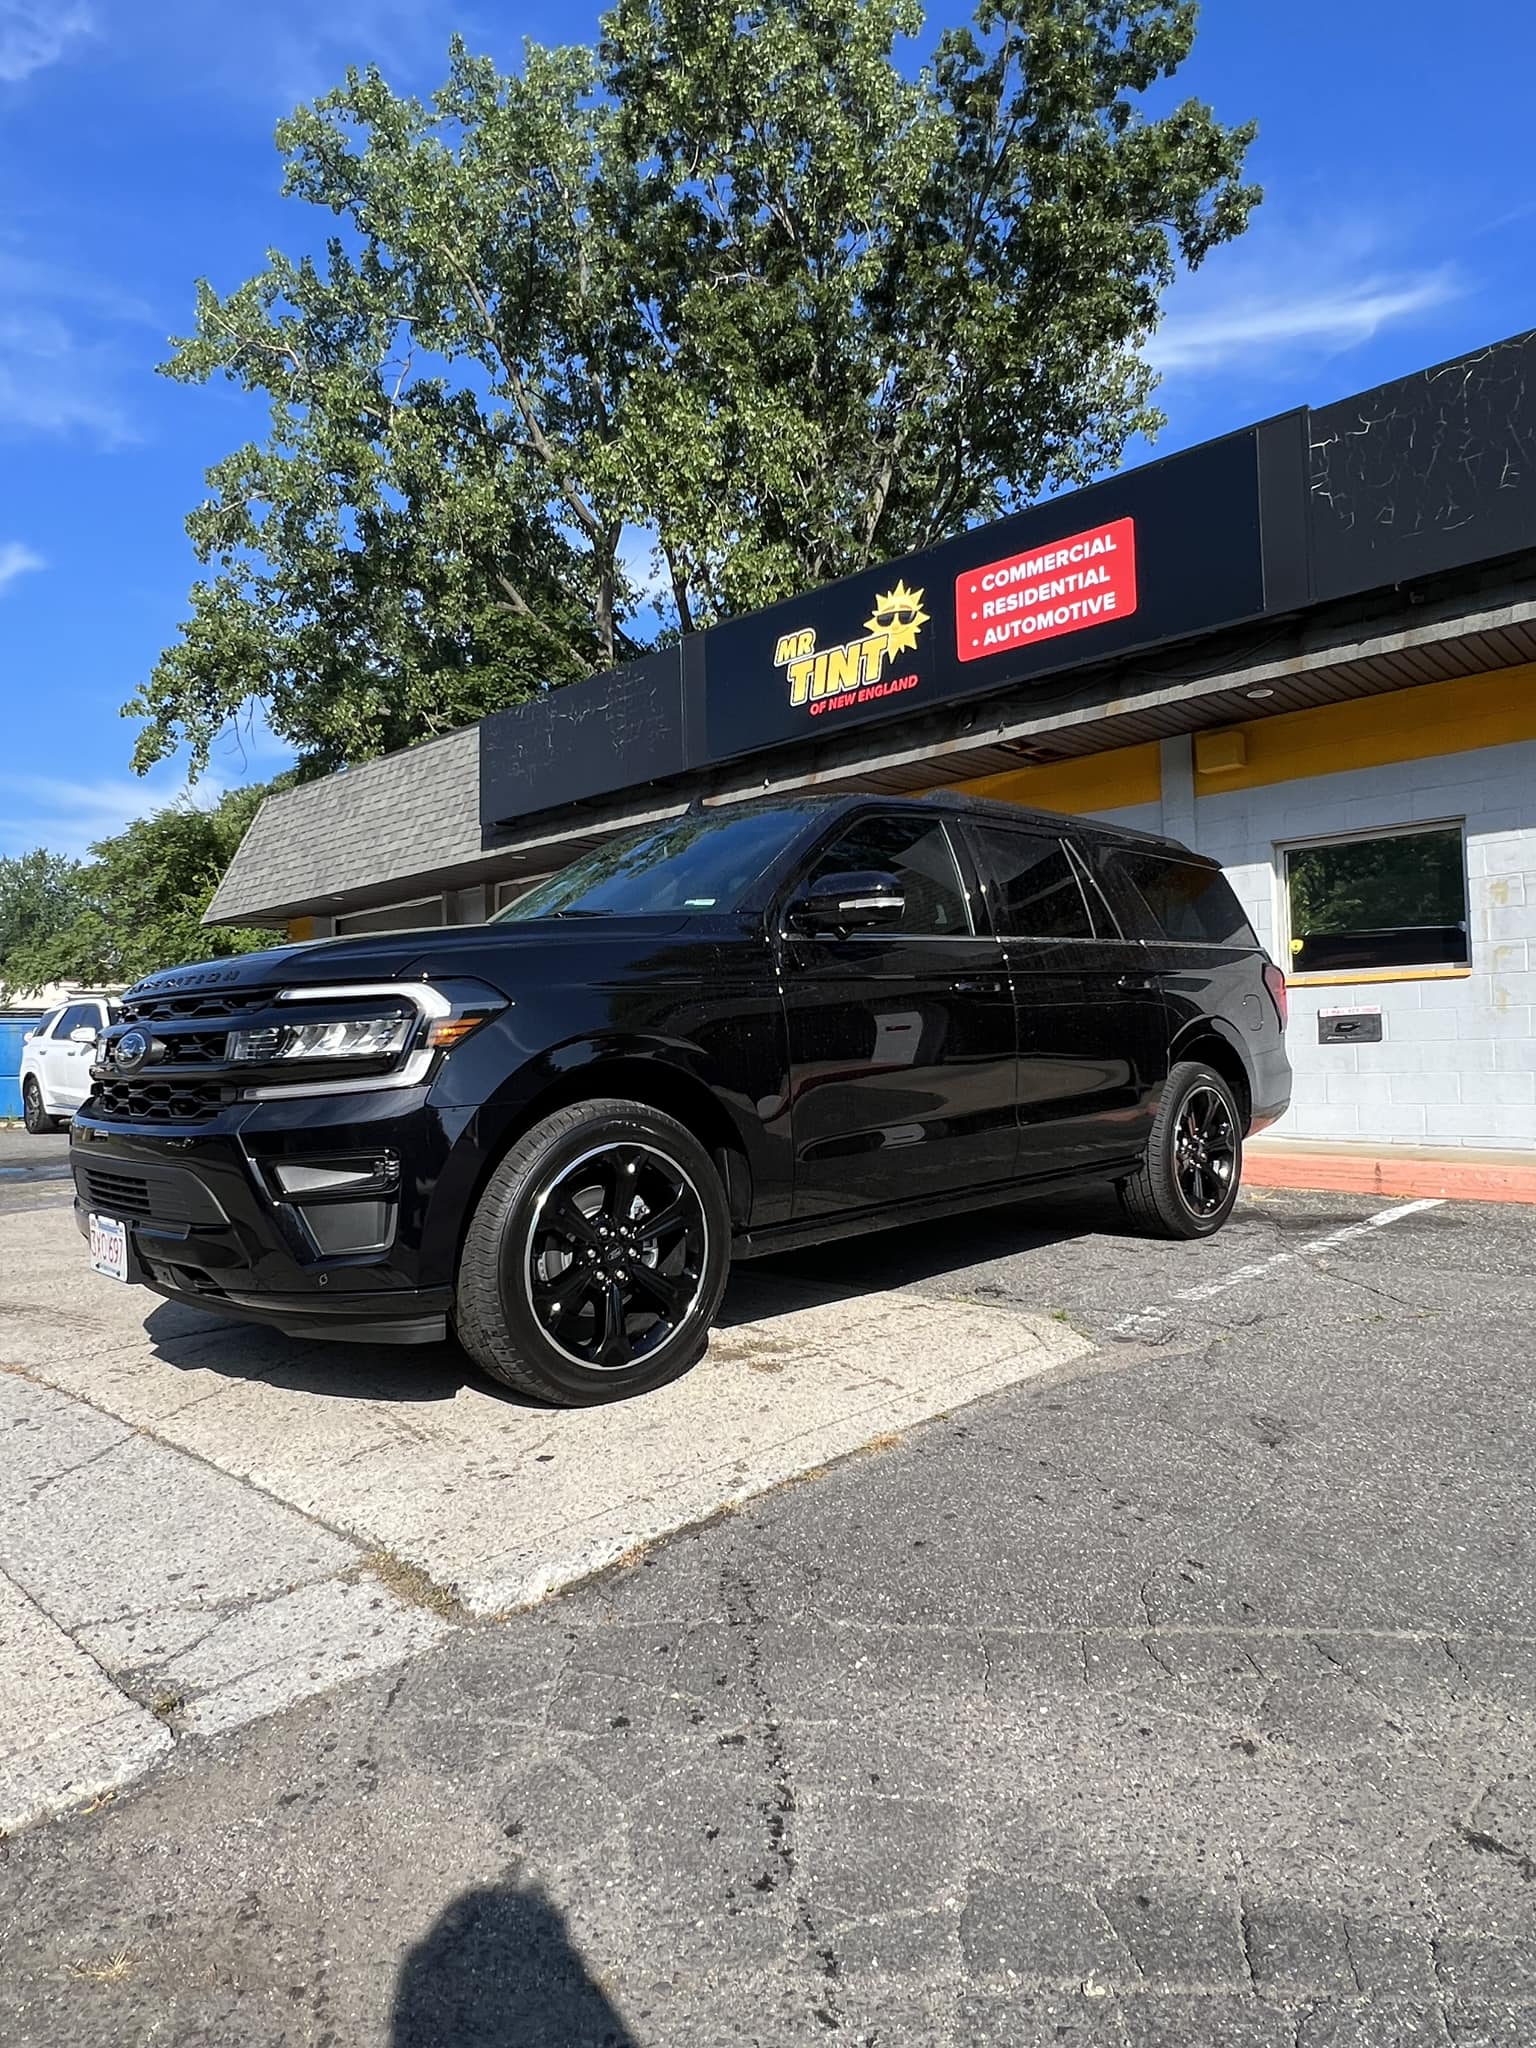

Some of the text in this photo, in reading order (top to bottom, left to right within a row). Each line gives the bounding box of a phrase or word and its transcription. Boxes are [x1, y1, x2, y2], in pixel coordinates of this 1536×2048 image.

[981, 534, 1117, 591] COMMERCIAL
[982, 566, 1111, 619] RESIDENTIAL
[983, 591, 1116, 647] AUTOMOTIVE
[775, 629, 816, 666] MR
[788, 632, 889, 706] TINT
[809, 674, 919, 716] OF NEW ENGLAND
